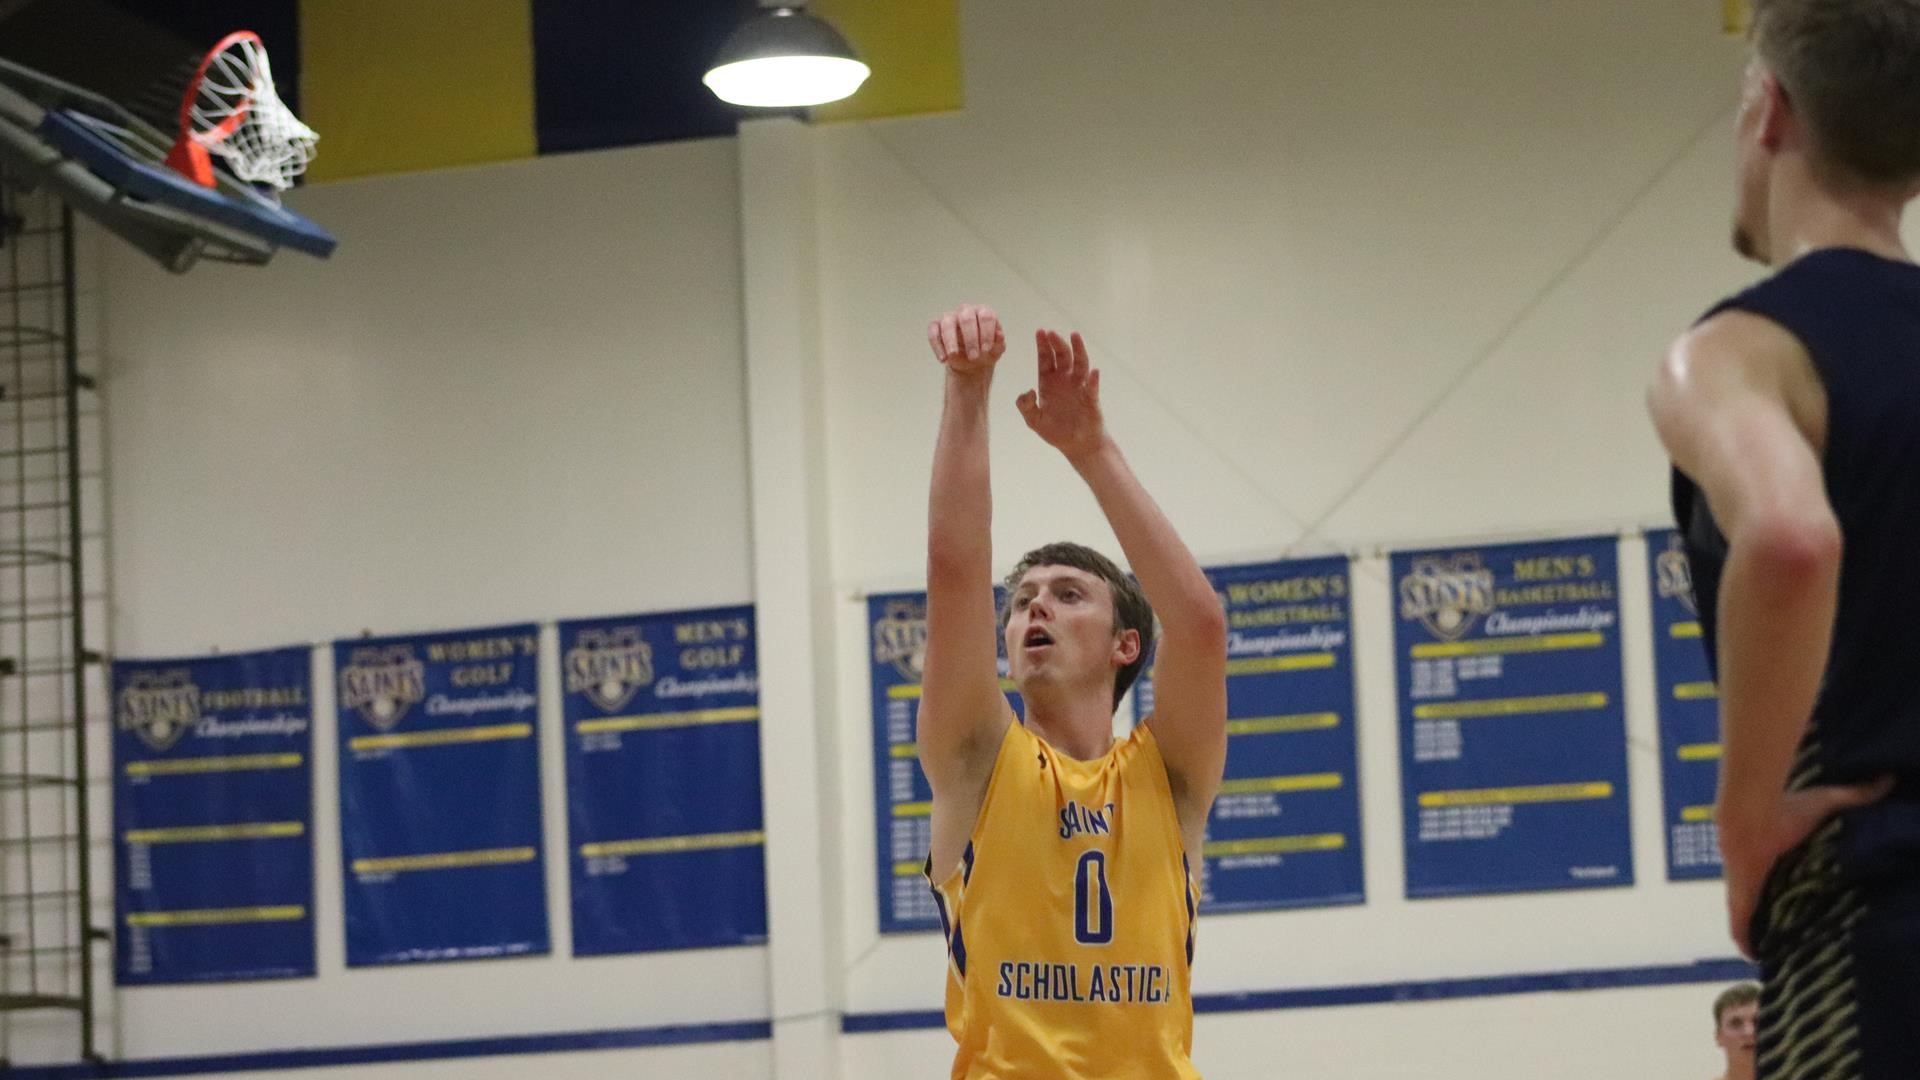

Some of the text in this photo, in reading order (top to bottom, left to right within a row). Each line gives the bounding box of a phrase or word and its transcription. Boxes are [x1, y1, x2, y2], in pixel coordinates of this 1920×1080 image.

[1513, 556, 1594, 581] MEN'S
[1228, 574, 1345, 604] WOMEN'S
[1494, 580, 1613, 605] BASKETBALL
[675, 618, 748, 643] MEN'S
[1484, 605, 1615, 635] Championships
[429, 634, 539, 662] WOMEN'S
[679, 644, 743, 671] GOLF
[452, 662, 513, 688] GOLF
[1074, 849, 1112, 944] 0
